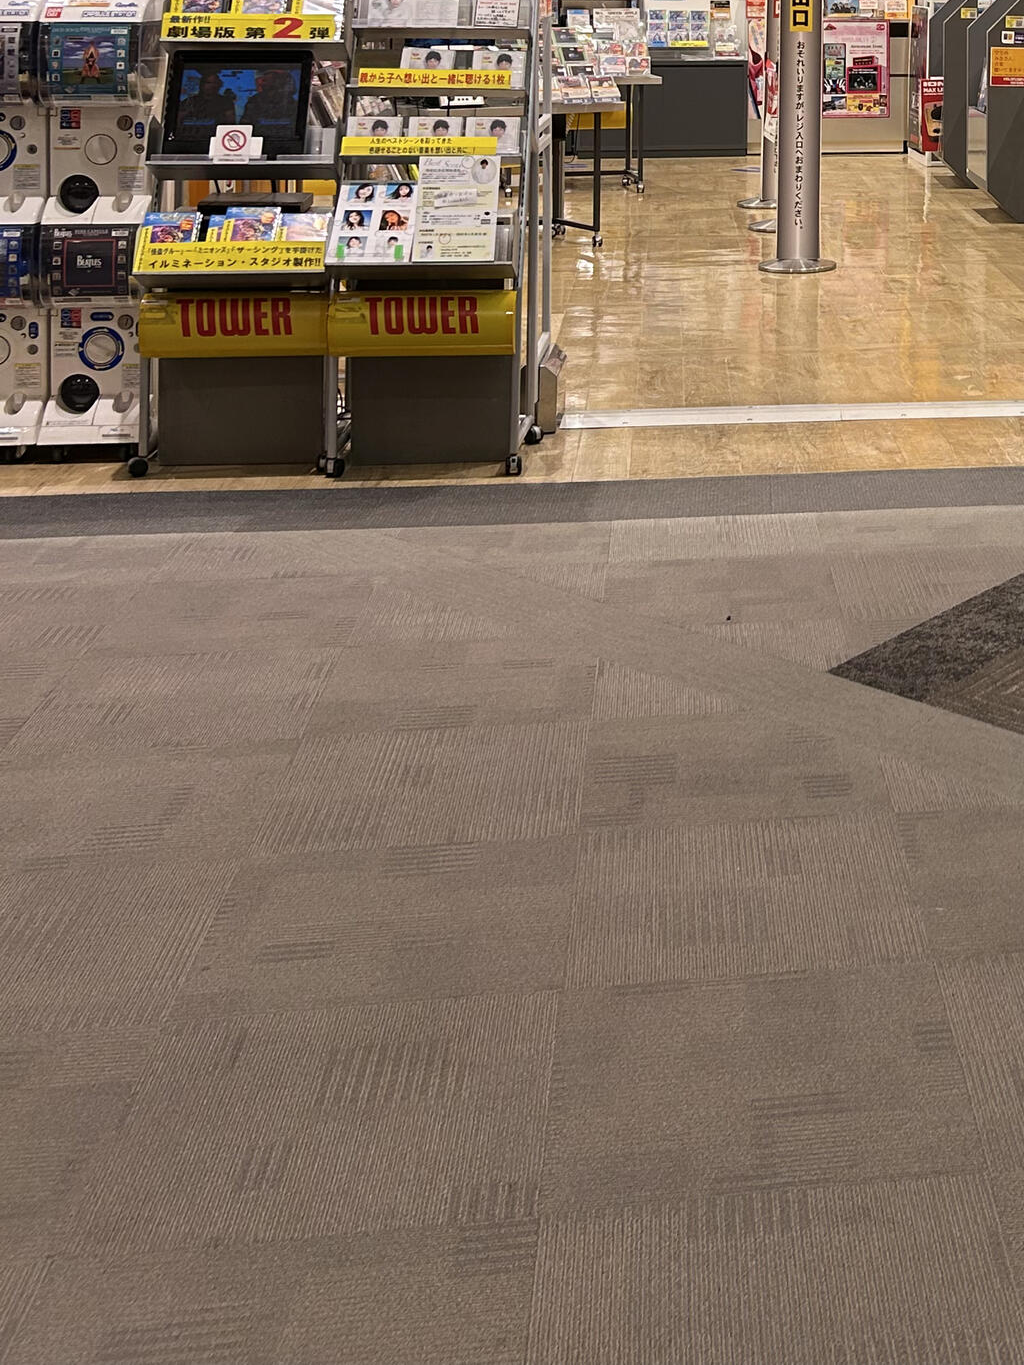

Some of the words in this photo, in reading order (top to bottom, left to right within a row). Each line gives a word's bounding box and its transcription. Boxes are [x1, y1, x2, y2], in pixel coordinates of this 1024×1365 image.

[167, 26, 235, 39] 劇場版
[244, 17, 330, 39] 第2弾
[169, 15, 210, 24] 最新作!!
[176, 297, 293, 337] TOWER
[365, 296, 480, 336] TOWER
